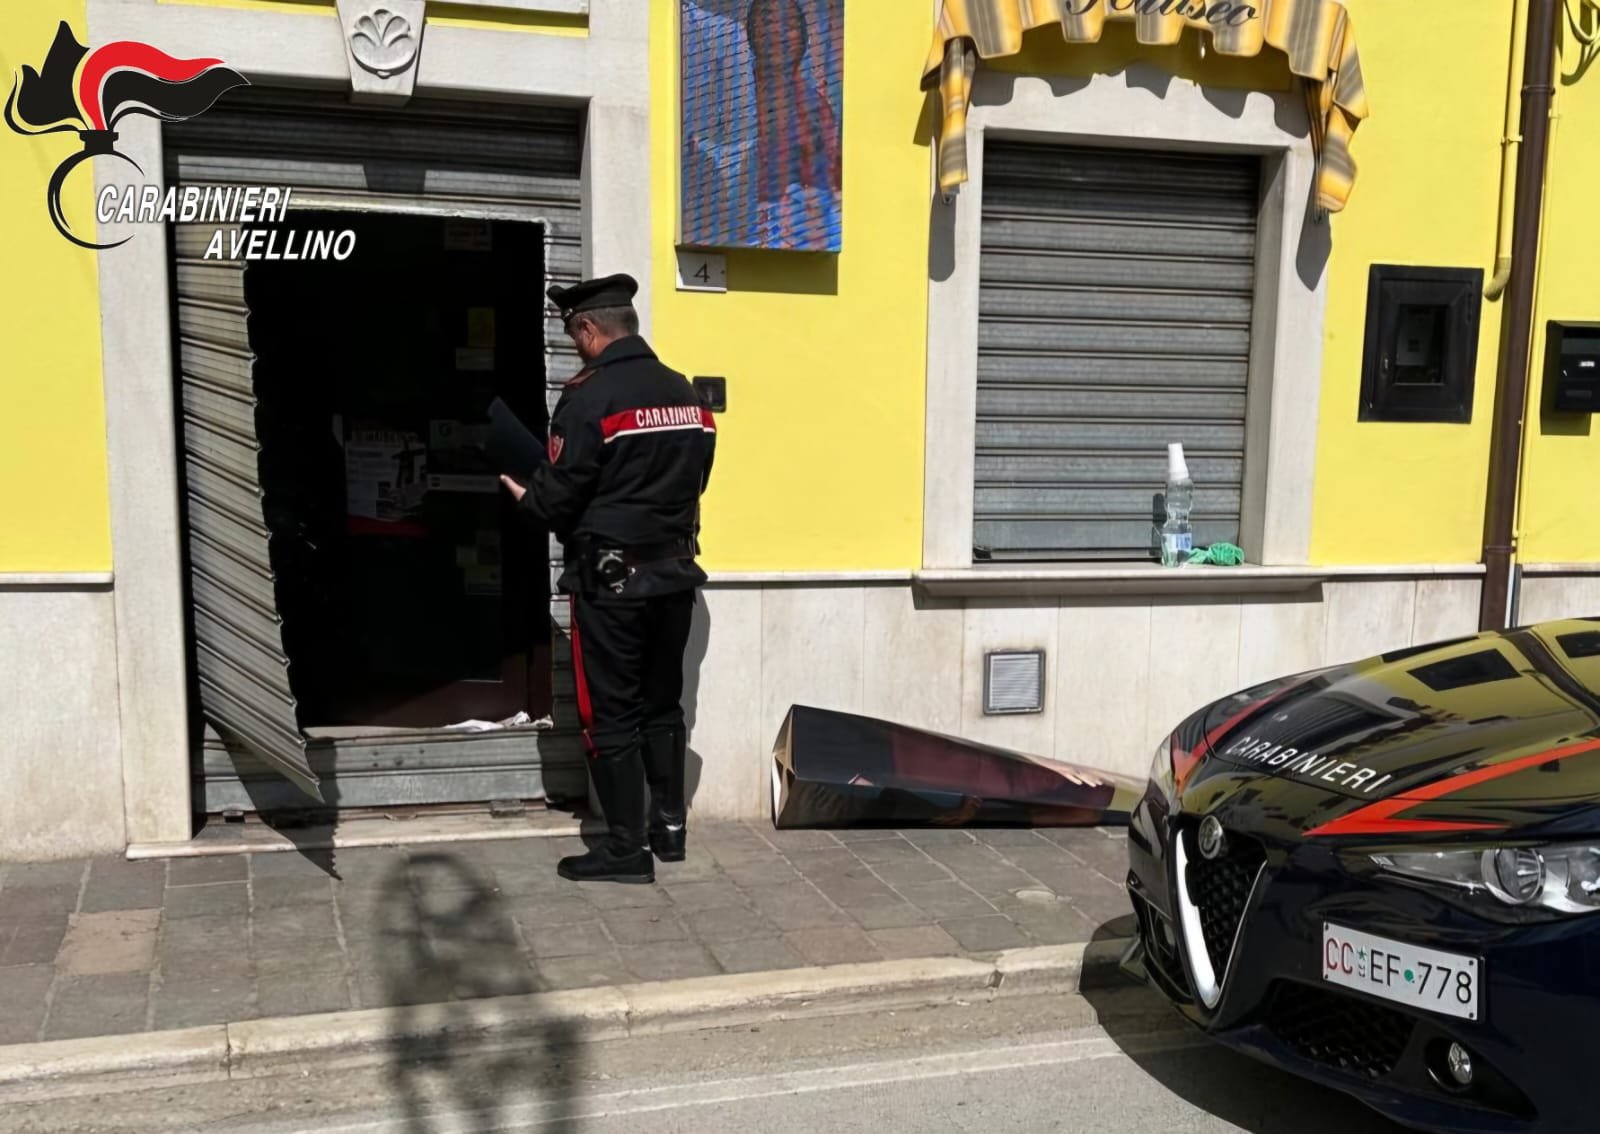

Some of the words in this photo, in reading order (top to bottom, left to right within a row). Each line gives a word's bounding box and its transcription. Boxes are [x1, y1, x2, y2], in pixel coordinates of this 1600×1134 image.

[693, 262, 711, 283] 4
[1225, 736, 1392, 793] CARABINIERI
[1325, 937, 1354, 975] CC
[1370, 948, 1401, 987] EF
[1417, 961, 1472, 1004] 778
